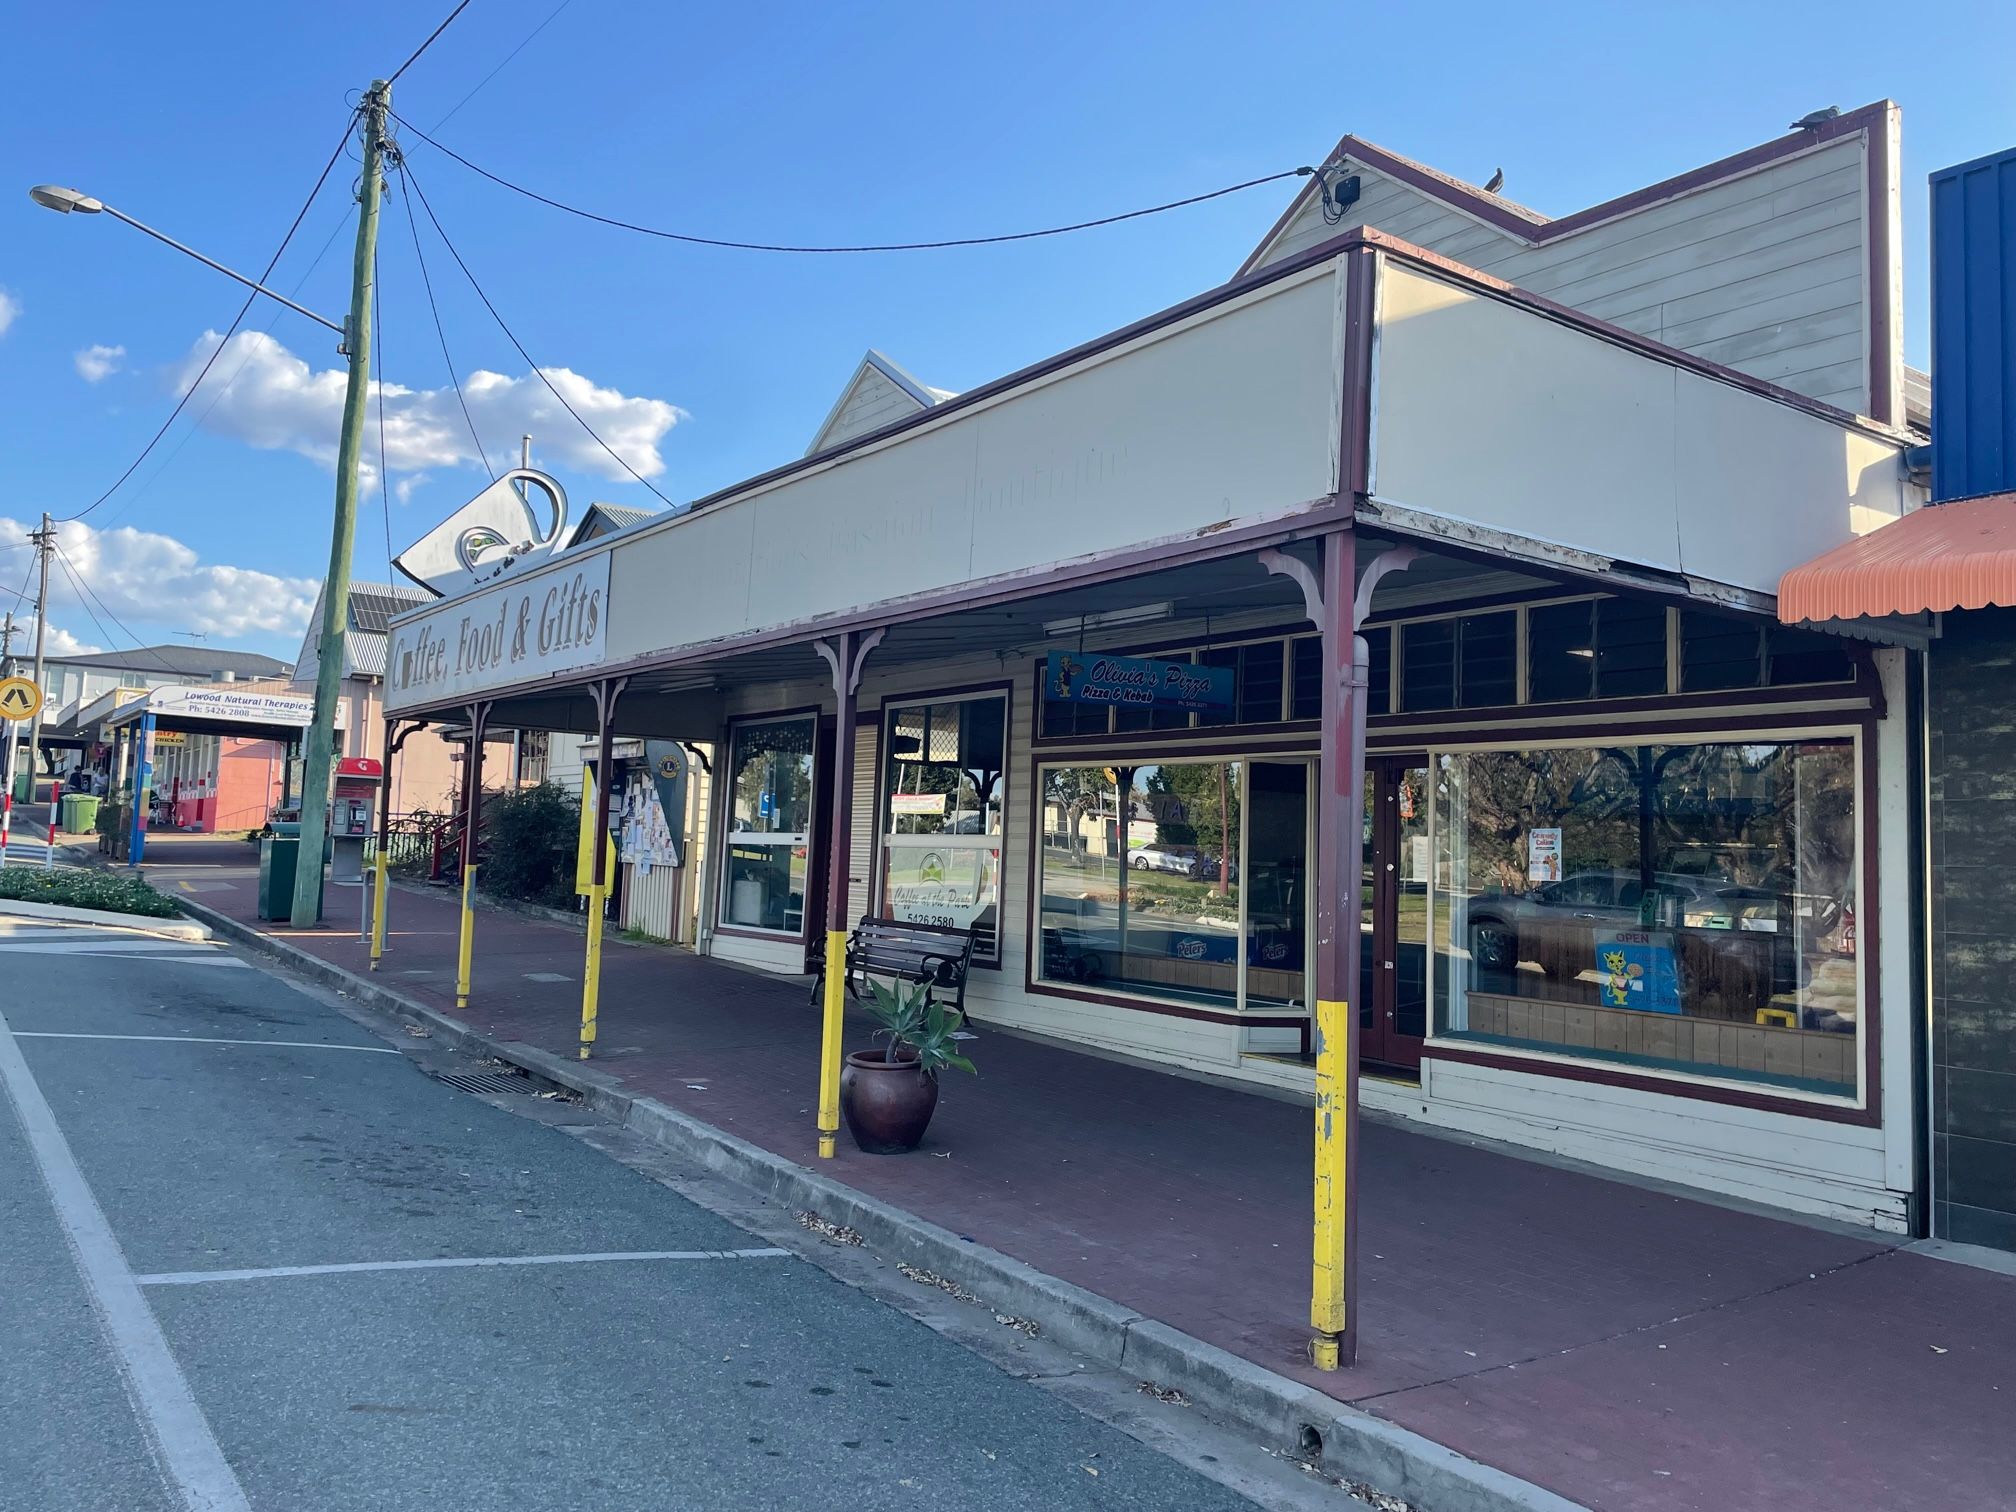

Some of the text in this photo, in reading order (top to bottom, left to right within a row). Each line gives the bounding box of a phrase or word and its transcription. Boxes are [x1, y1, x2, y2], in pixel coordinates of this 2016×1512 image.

[391, 573, 600, 692] Cffee, Food & Gifts
[1090, 659, 1212, 699] Olivia's Pizza
[184, 692, 221, 702] Lowood
[224, 695, 262, 706] Natural
[264, 699, 308, 711] Therapies
[1081, 684, 1154, 703] Pizza & Kebab
[188, 704, 203, 712] Ph:
[205, 706, 226, 715] 5426
[228, 708, 250, 717] 2808
[931, 916, 954, 928] 2580
[1616, 933, 1649, 944] OPEN
[1177, 941, 1207, 958] Peters
